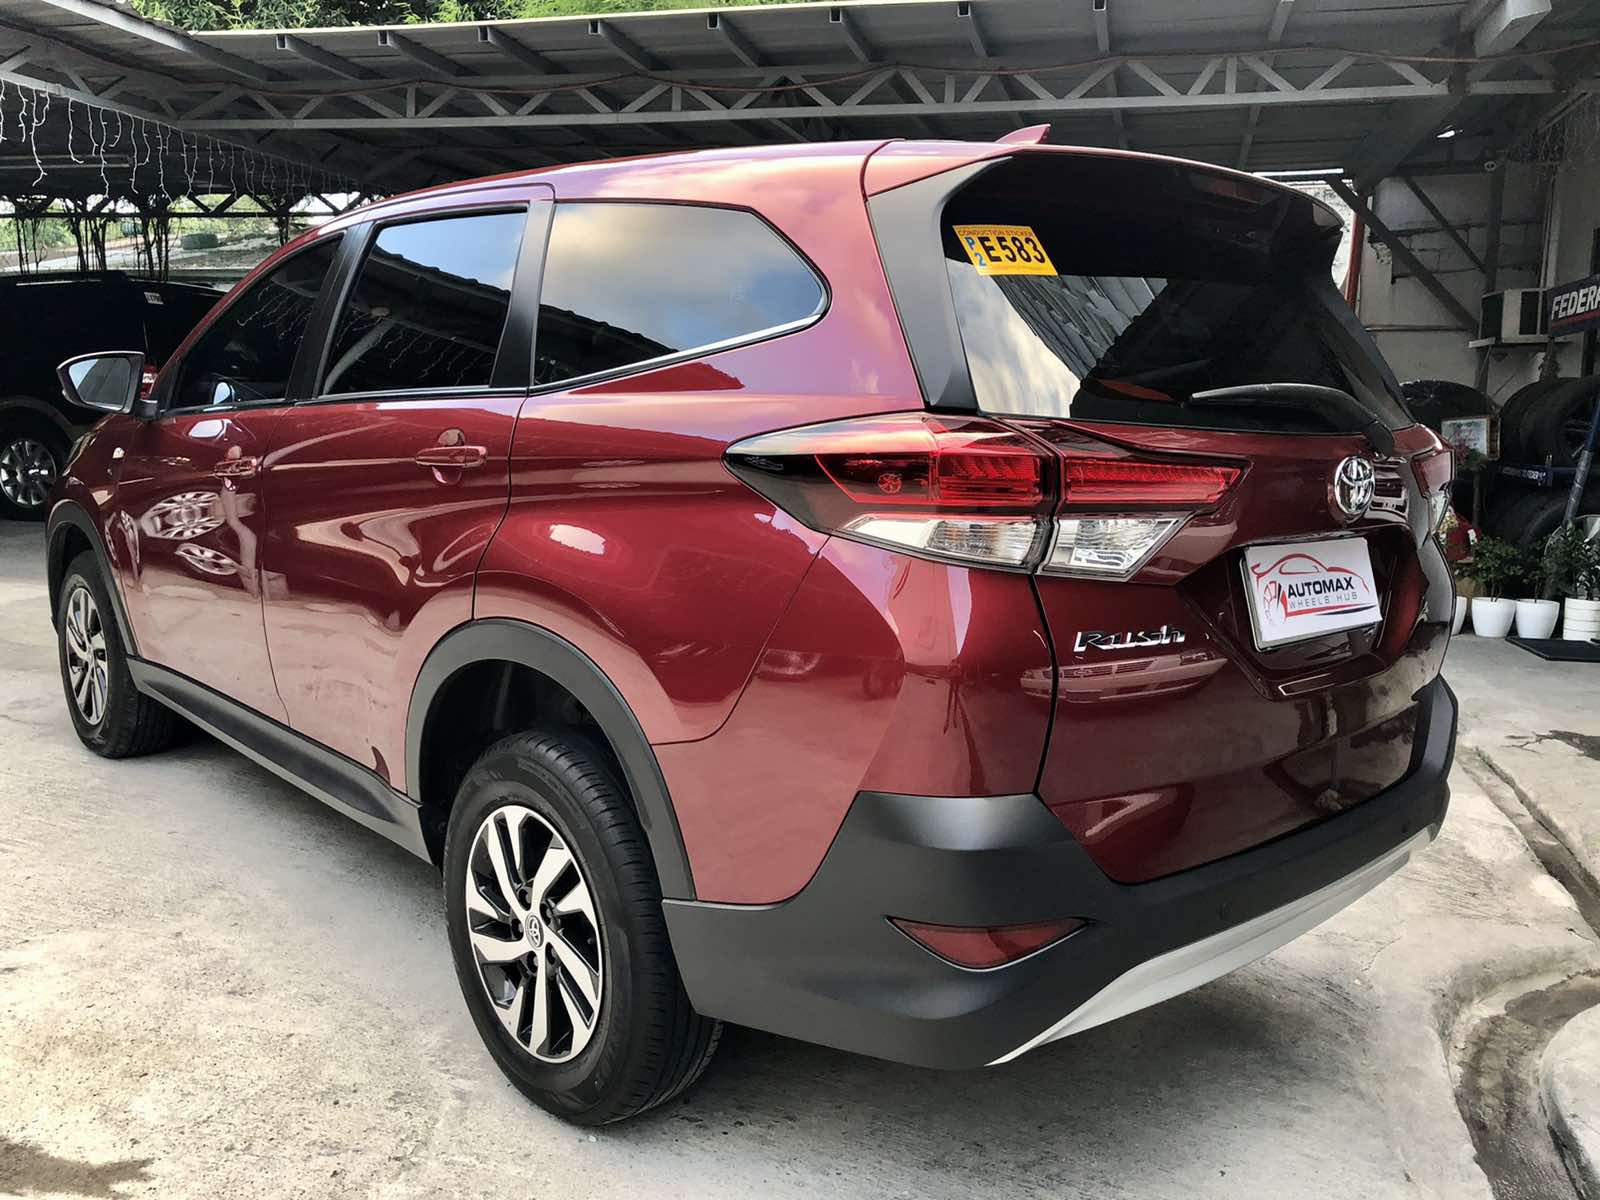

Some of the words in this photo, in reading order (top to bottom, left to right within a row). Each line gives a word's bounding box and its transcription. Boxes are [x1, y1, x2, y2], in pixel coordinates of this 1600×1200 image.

[977, 236, 1046, 264] E583
[1288, 577, 1355, 598] AUTOMAX
[1290, 595, 1330, 608] WHEELS
[1336, 592, 1358, 602] HUB
[1073, 625, 1185, 652] Rush
